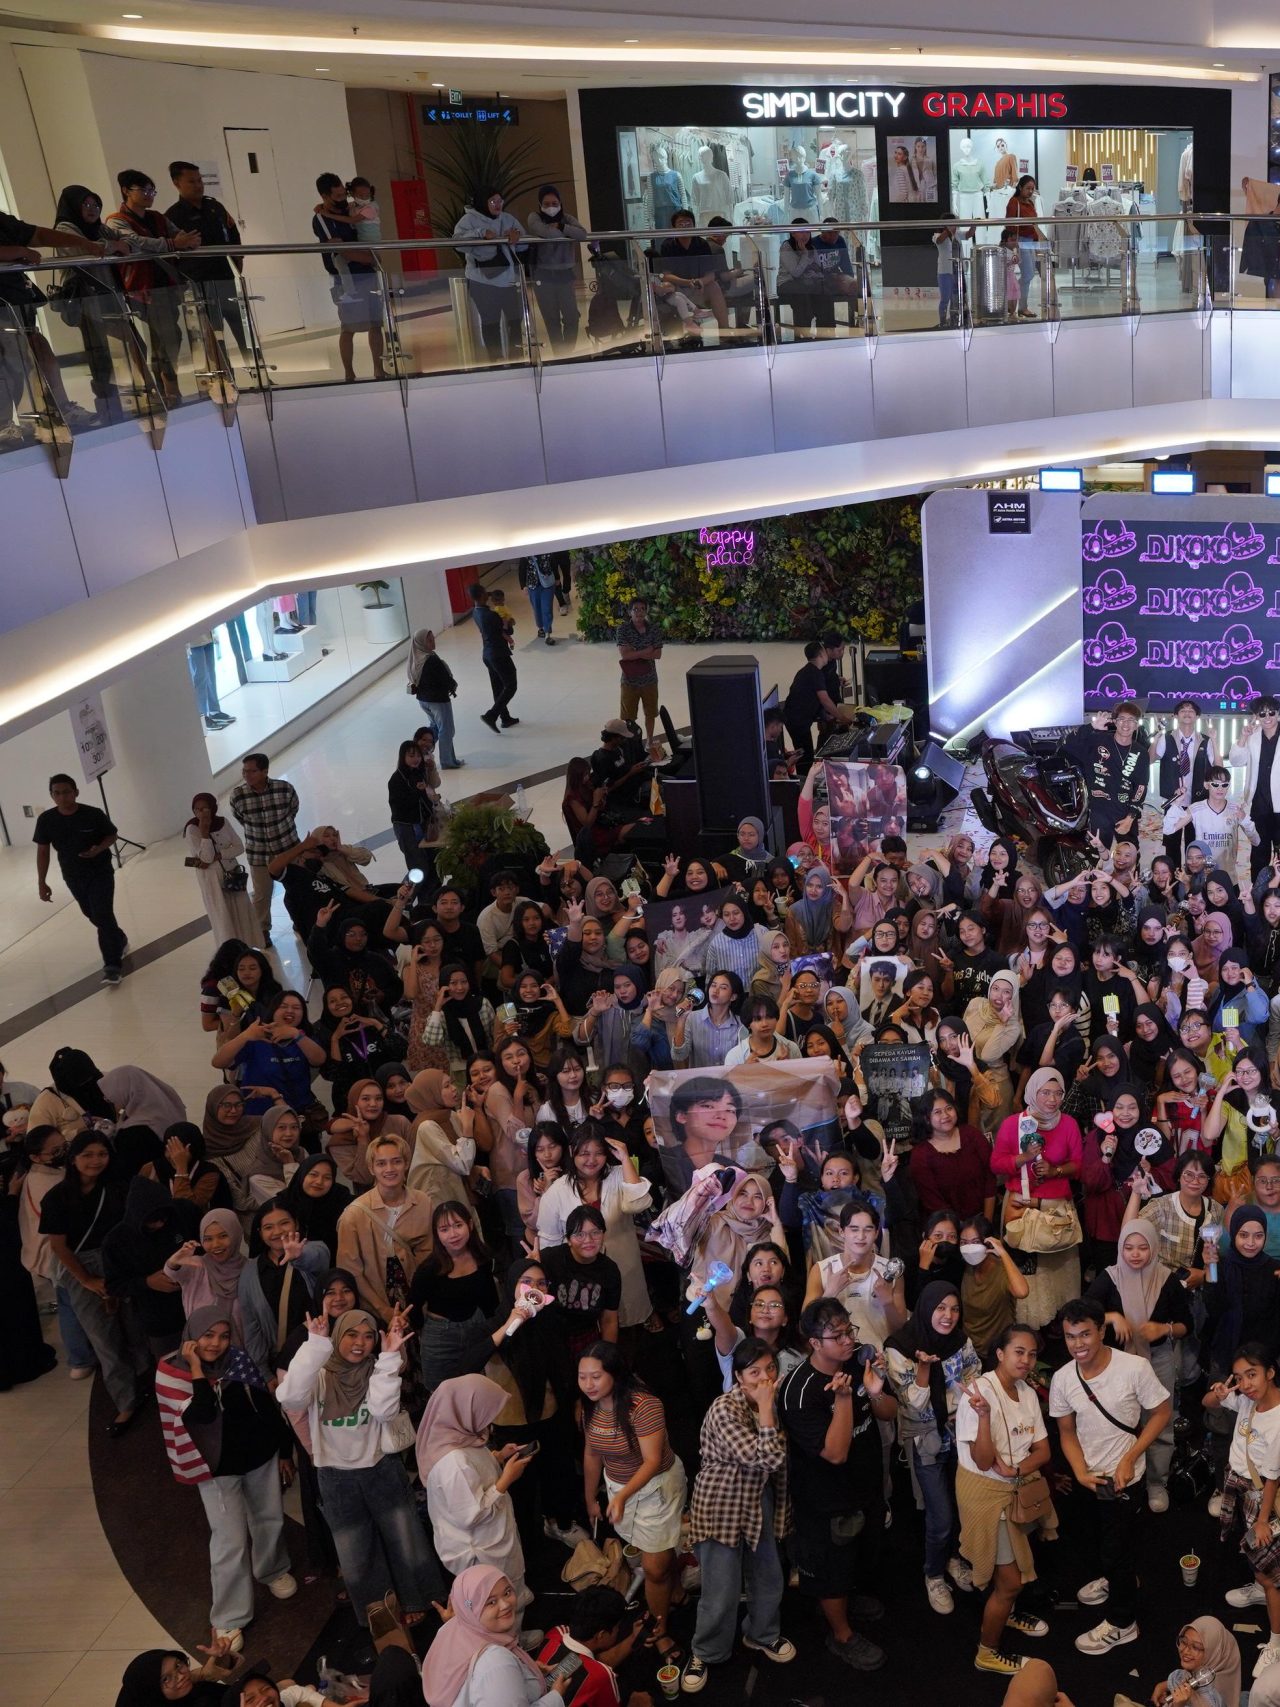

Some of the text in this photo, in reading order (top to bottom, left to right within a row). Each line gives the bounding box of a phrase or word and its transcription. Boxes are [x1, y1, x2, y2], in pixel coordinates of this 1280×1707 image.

[742, 92, 905, 118] SIMPLICITY
[923, 92, 1068, 118] GRAPHIS
[700, 527, 754, 550] happy
[1142, 534, 1232, 564] DJ KOKO
[706, 546, 755, 573] place
[1142, 588, 1231, 617] DJ KOKO
[1142, 640, 1231, 668] DJ KOKO
[1203, 832, 1233, 840] Emirates
